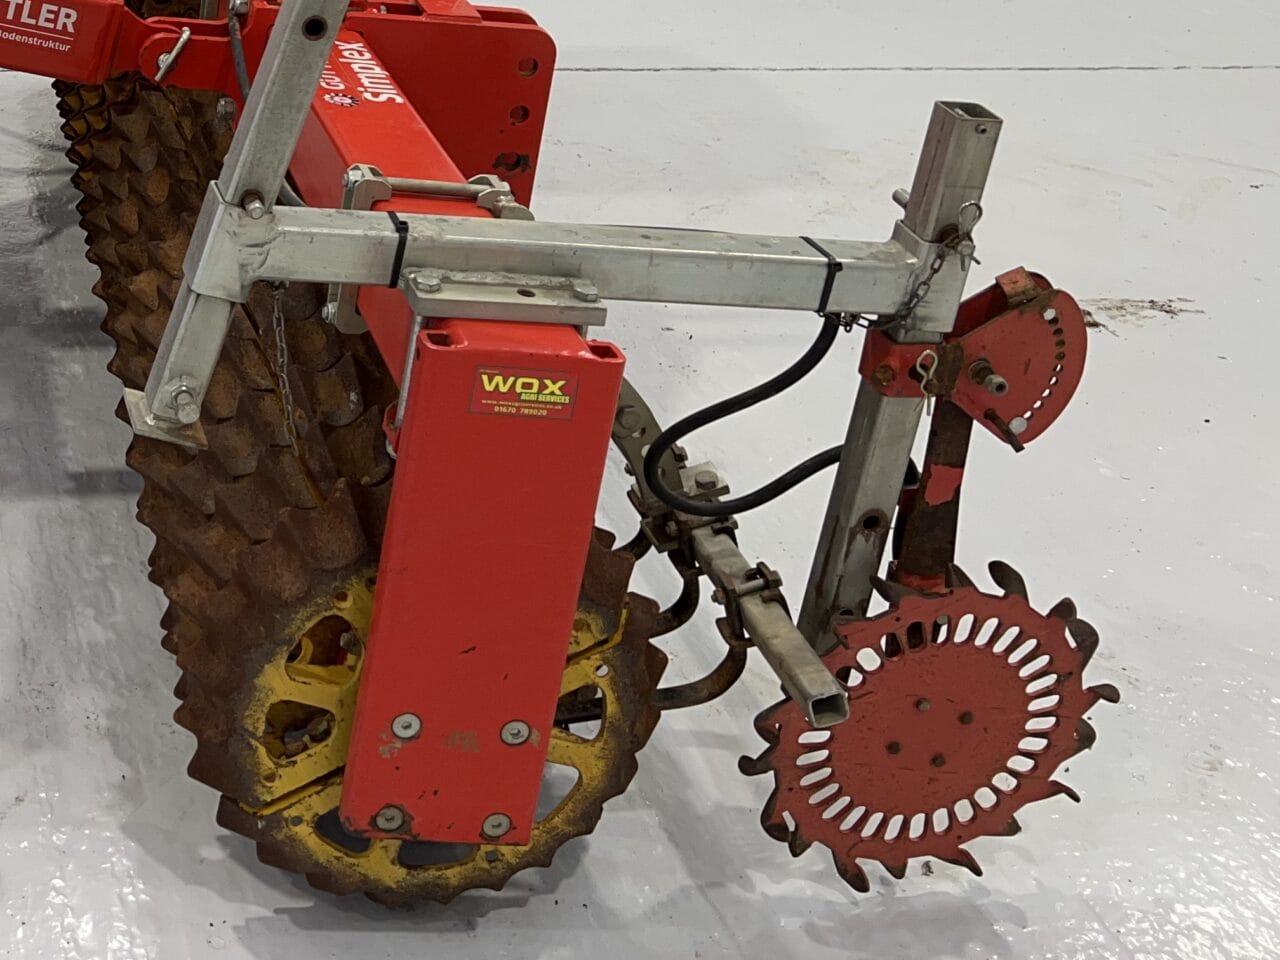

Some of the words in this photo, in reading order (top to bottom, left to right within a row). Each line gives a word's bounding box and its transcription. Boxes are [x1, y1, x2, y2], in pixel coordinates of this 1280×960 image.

[334, 40, 405, 104] Simplex
[481, 374, 567, 395] WOX
[538, 394, 569, 403] SERVICES
